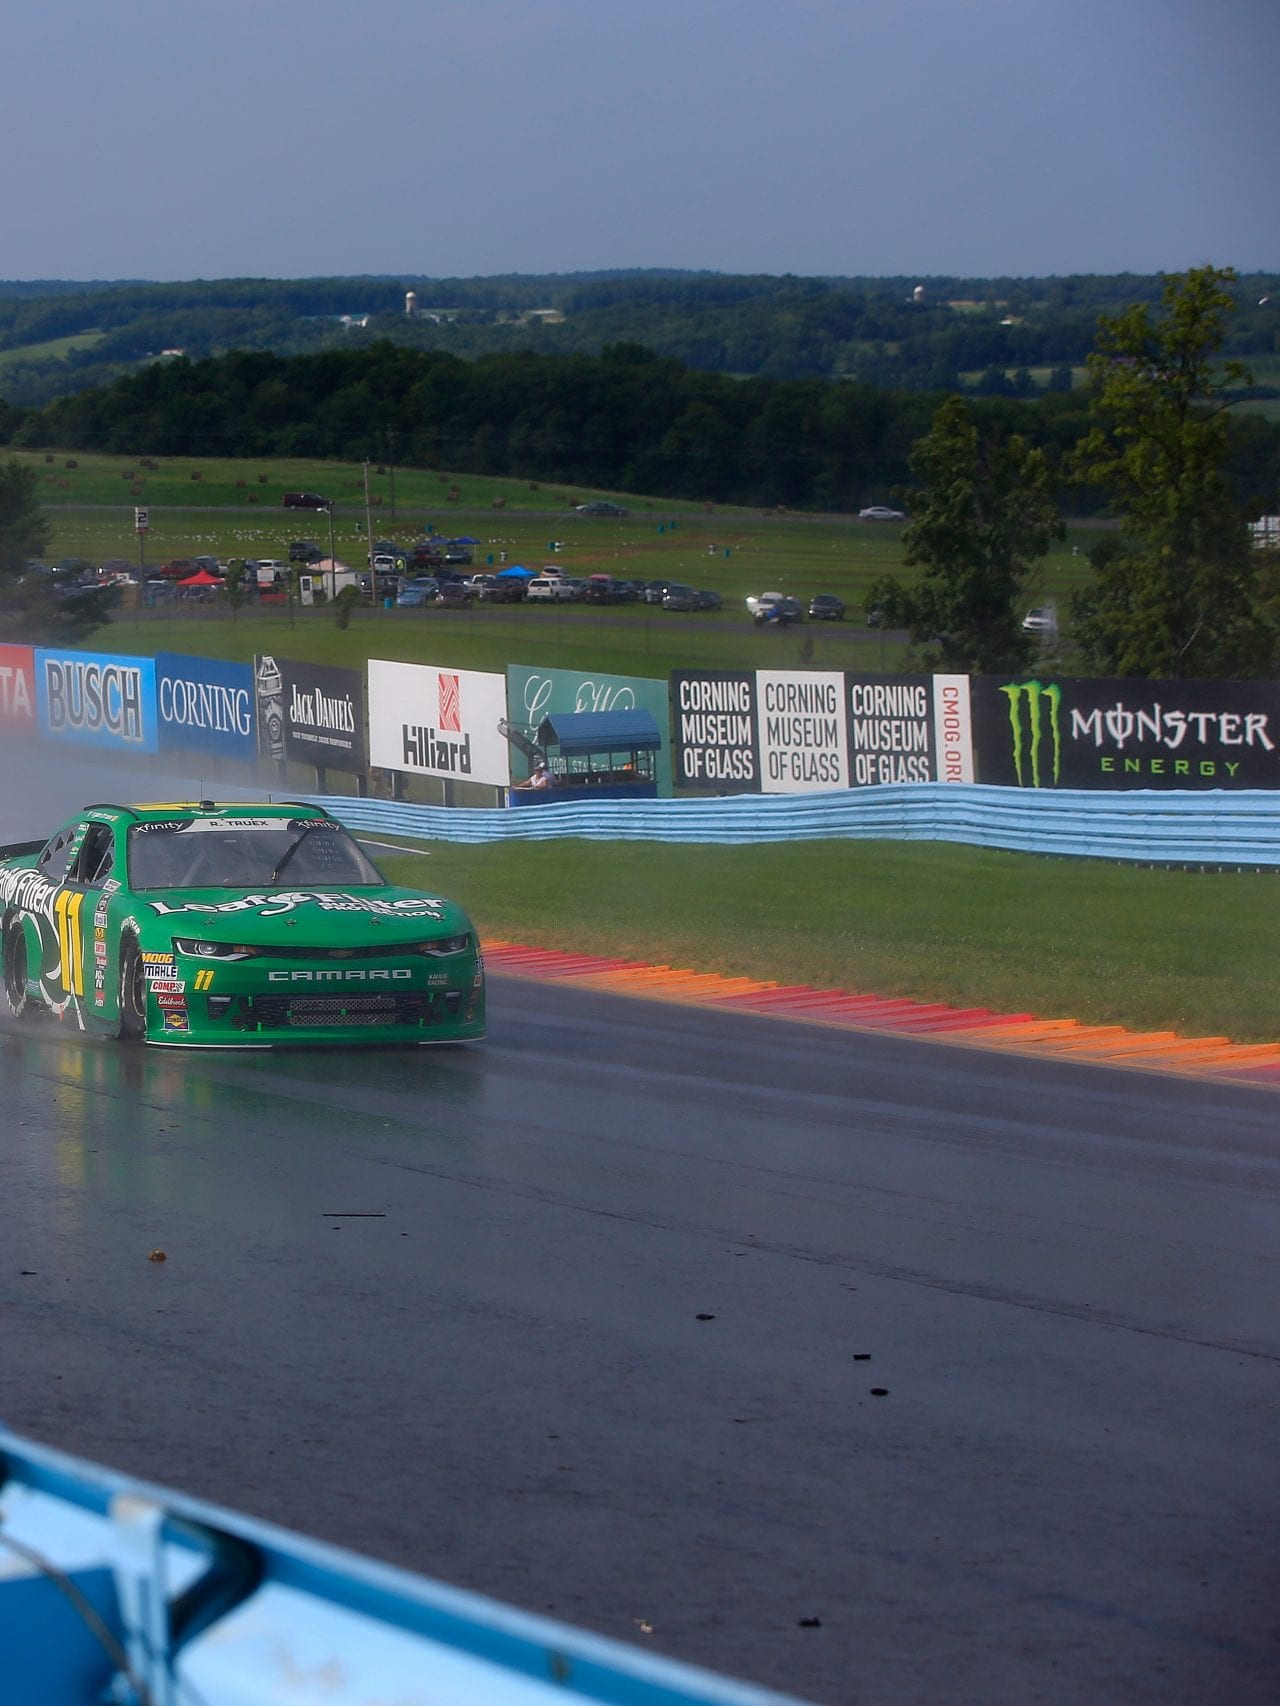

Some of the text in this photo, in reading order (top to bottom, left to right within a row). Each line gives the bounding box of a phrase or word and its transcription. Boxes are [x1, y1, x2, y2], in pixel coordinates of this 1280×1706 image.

[138, 512, 147, 523] 2
[44, 659, 144, 742] BUSCH
[160, 677, 251, 736] CORNING
[680, 680, 751, 712] CORNING
[765, 682, 836, 714] CORNING
[851, 685, 927, 718] CORNING
[682, 714, 752, 746] MUSEUM
[767, 716, 838, 748] MUSEUM
[853, 719, 929, 752] MUSEUM
[1071, 702, 1275, 751] MONSTER
[402, 724, 472, 775] Hilliard
[684, 748, 754, 780] OF GLASS
[769, 751, 840, 783] OF GLASS
[855, 754, 931, 784] OF GLASS
[1100, 757, 1240, 777] ENERGY
[135, 821, 184, 833] xfinity
[298, 820, 340, 831] xfinity
[55, 889, 84, 996] 11
[145, 965, 177, 978] MAHLE
[152, 981, 176, 990] COMP
[194, 970, 215, 991] 11
[269, 969, 412, 981] CAMARO
